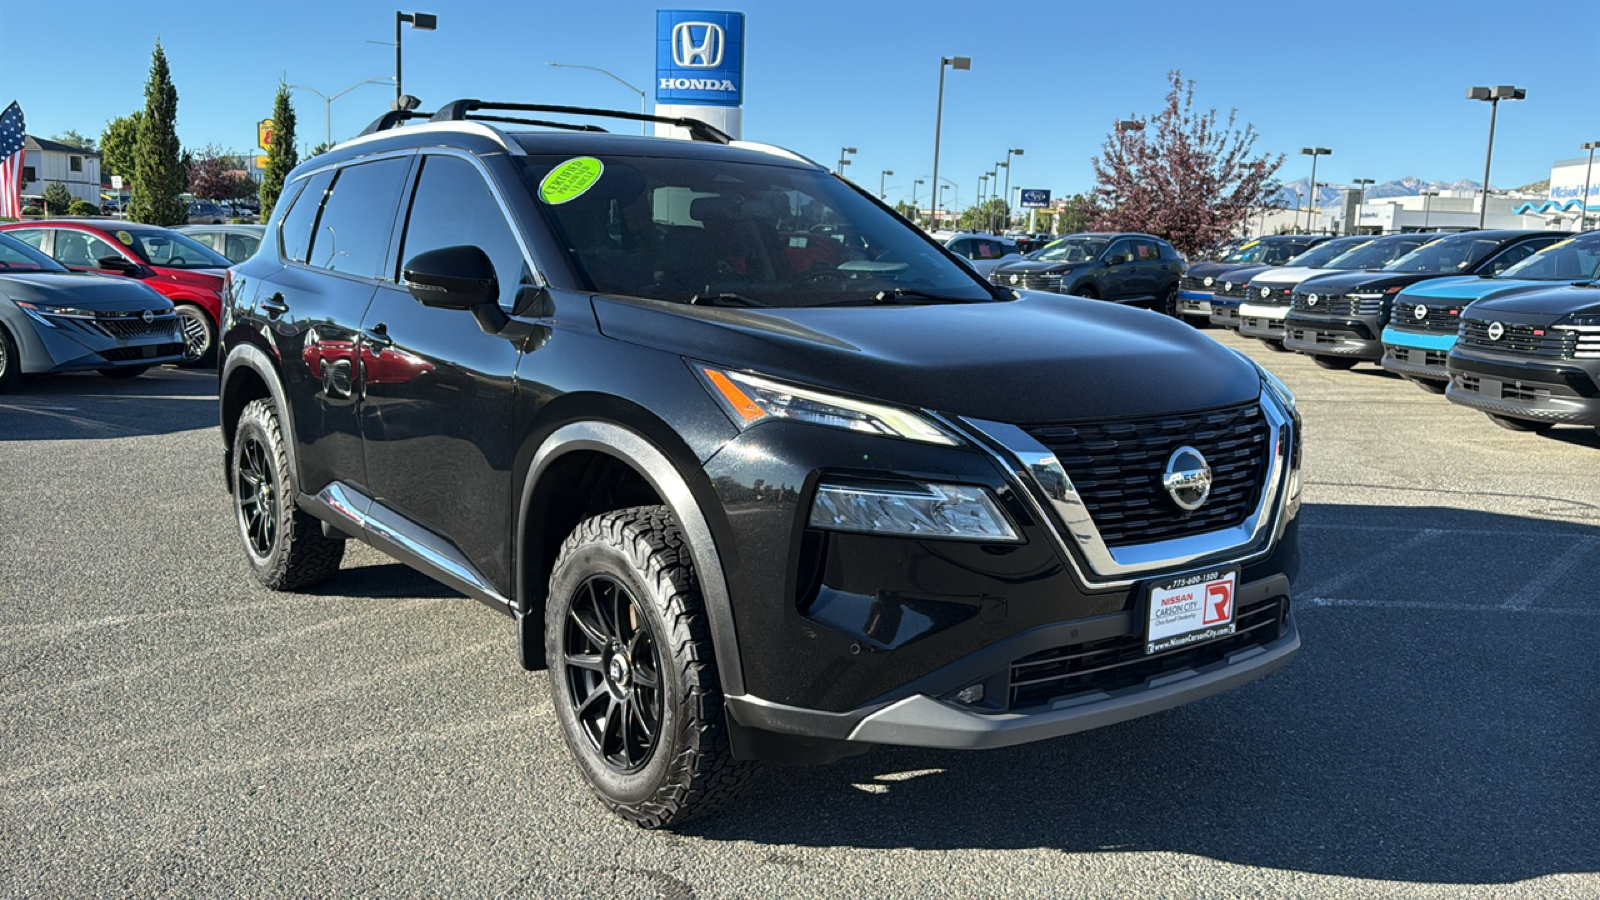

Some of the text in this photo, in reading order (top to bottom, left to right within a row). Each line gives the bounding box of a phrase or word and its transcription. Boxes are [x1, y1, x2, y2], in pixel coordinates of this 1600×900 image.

[659, 78, 737, 92] HONDA
[544, 161, 583, 194] CERTIFIED
[1172, 571, 1219, 588] 775-600-1500
[1161, 593, 1194, 606] NISSAN
[1155, 600, 1198, 618] CARSON CITY
[1154, 628, 1229, 651] www.NissanCarsonCity.com
